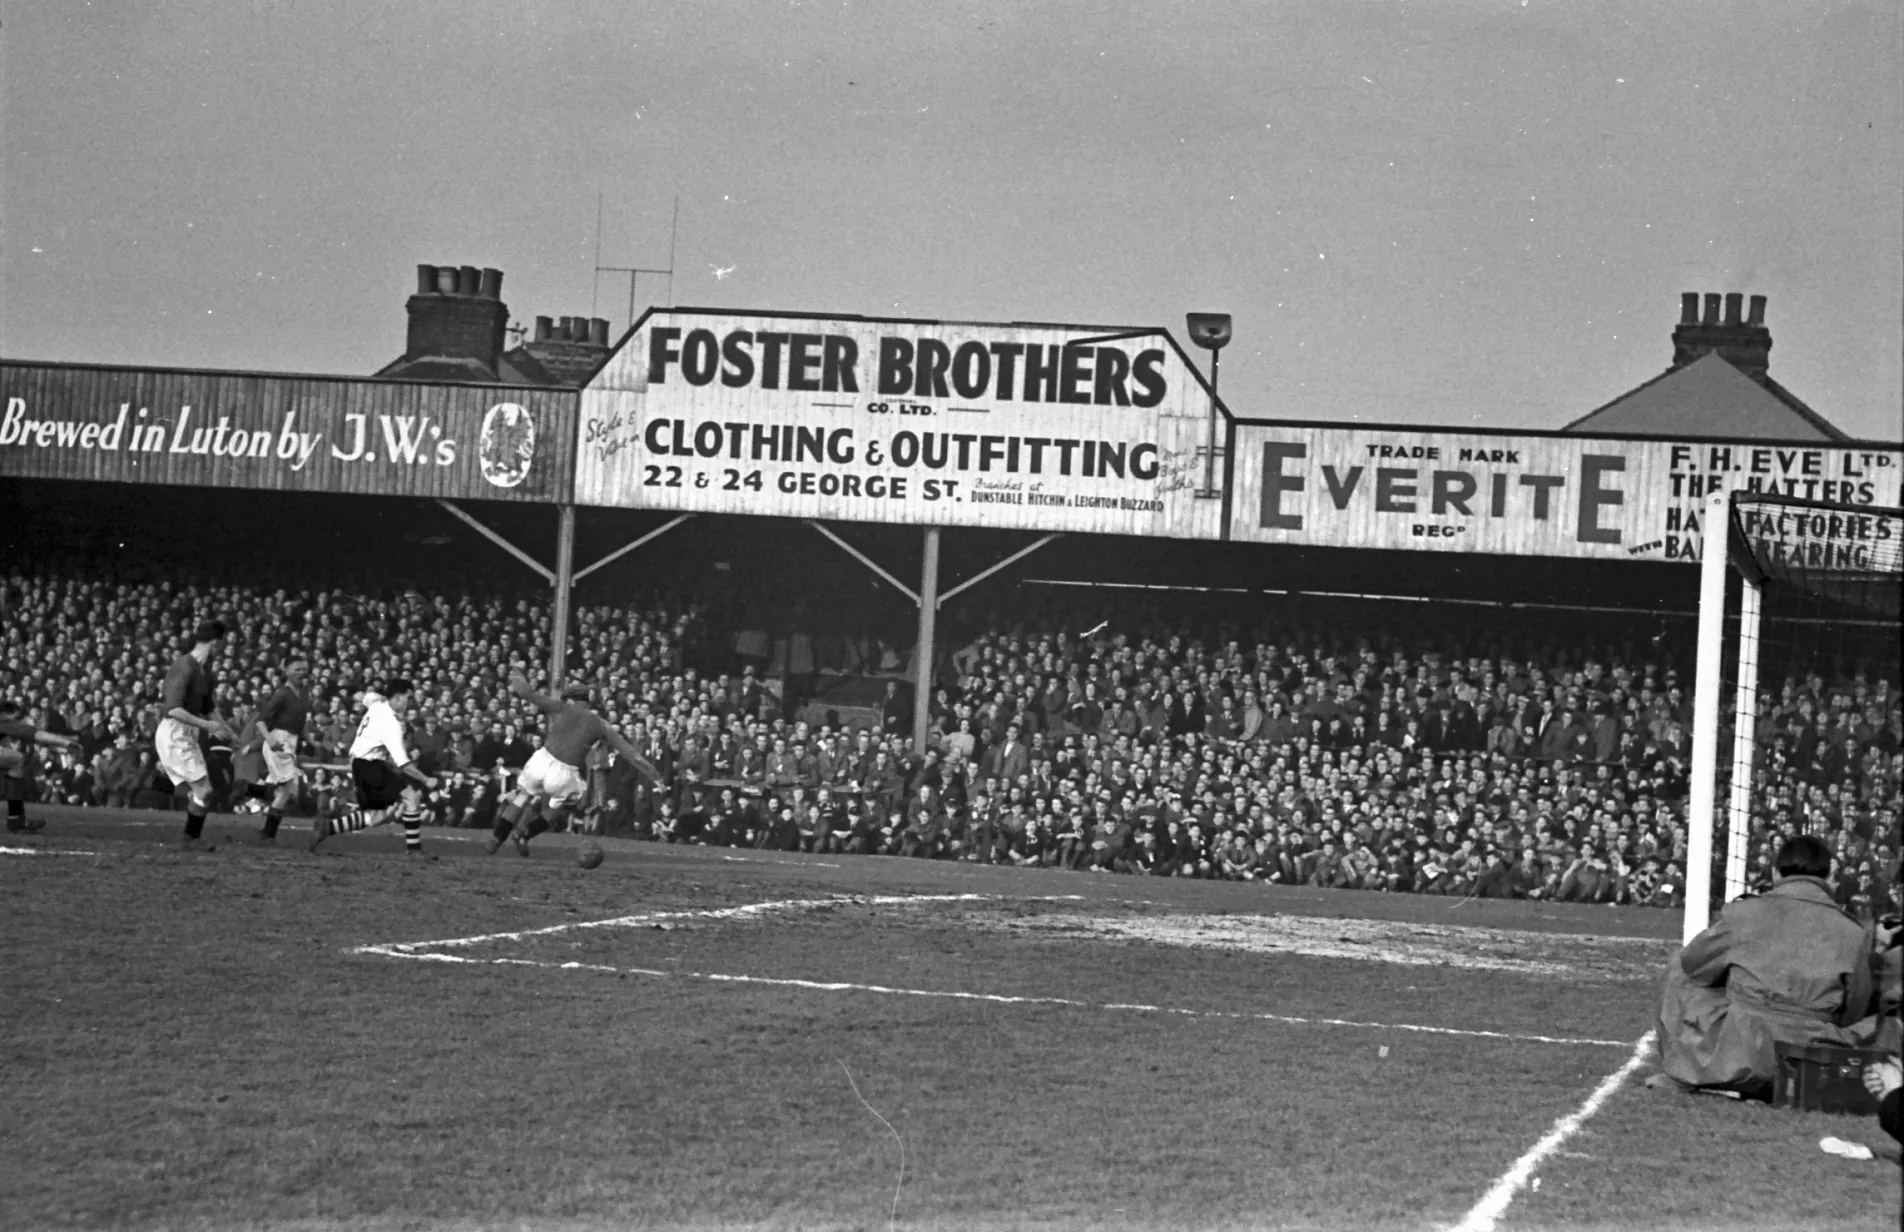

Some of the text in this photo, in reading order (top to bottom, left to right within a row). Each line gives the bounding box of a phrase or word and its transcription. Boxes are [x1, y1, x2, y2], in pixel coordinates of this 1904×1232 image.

[646, 326, 1168, 408] FOSTER BROTHERS
[867, 402, 937, 416] CO. LTD.
[0, 397, 129, 451] Brewed
[128, 407, 166, 453] in
[169, 405, 273, 458] Luton
[276, 410, 323, 472] by
[644, 417, 1160, 481] CLOTHING & OUTFITTING
[1366, 444, 1520, 464] TRADE MARK
[1751, 449, 1822, 476] EVE
[1843, 452, 1897, 477] LTD.
[643, 464, 962, 503] 22 & 24 GEORGE ST.
[1029, 482, 1045, 492] at
[1258, 441, 1625, 544] EVERITE
[1669, 473, 1876, 505] THE HATTERS
[971, 490, 1022, 504] DUNSTABLE
[1028, 492, 1066, 506] HITCHIN
[1075, 494, 1118, 509] LEIGHTON
[1120, 497, 1164, 512] BUZZARD
[1666, 507, 1892, 540] HA FACTORIES
